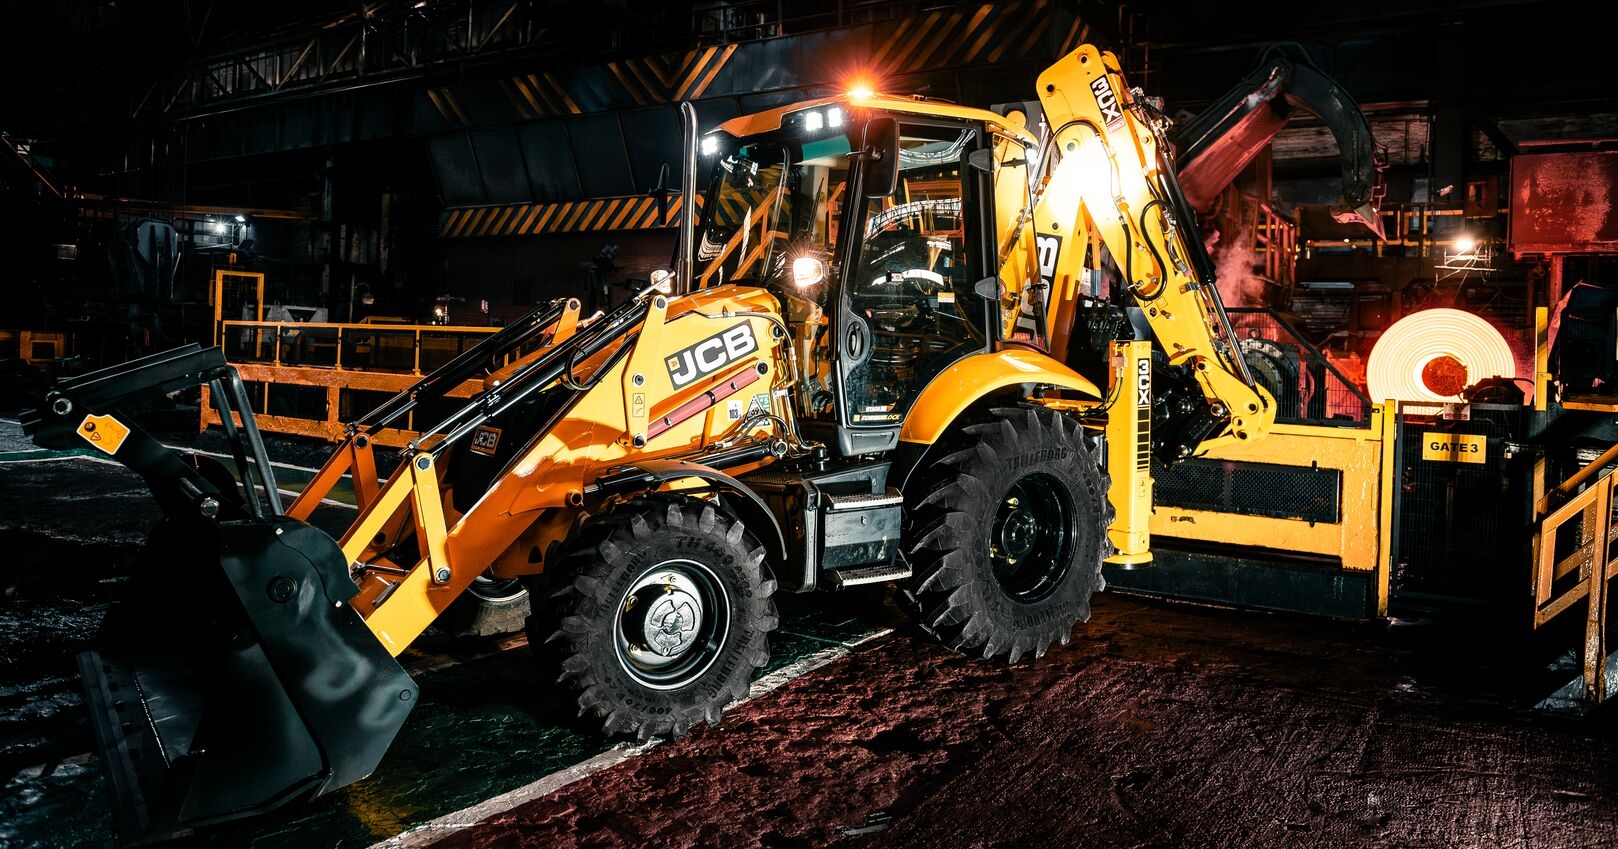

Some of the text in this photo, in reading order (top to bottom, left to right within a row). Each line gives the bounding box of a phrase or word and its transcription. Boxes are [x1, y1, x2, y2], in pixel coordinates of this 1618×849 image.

[1092, 77, 1121, 124] 3CX
[672, 324, 756, 385] JCB
[1138, 359, 1150, 405] 3CX
[1430, 441, 1479, 453] GATE 3
